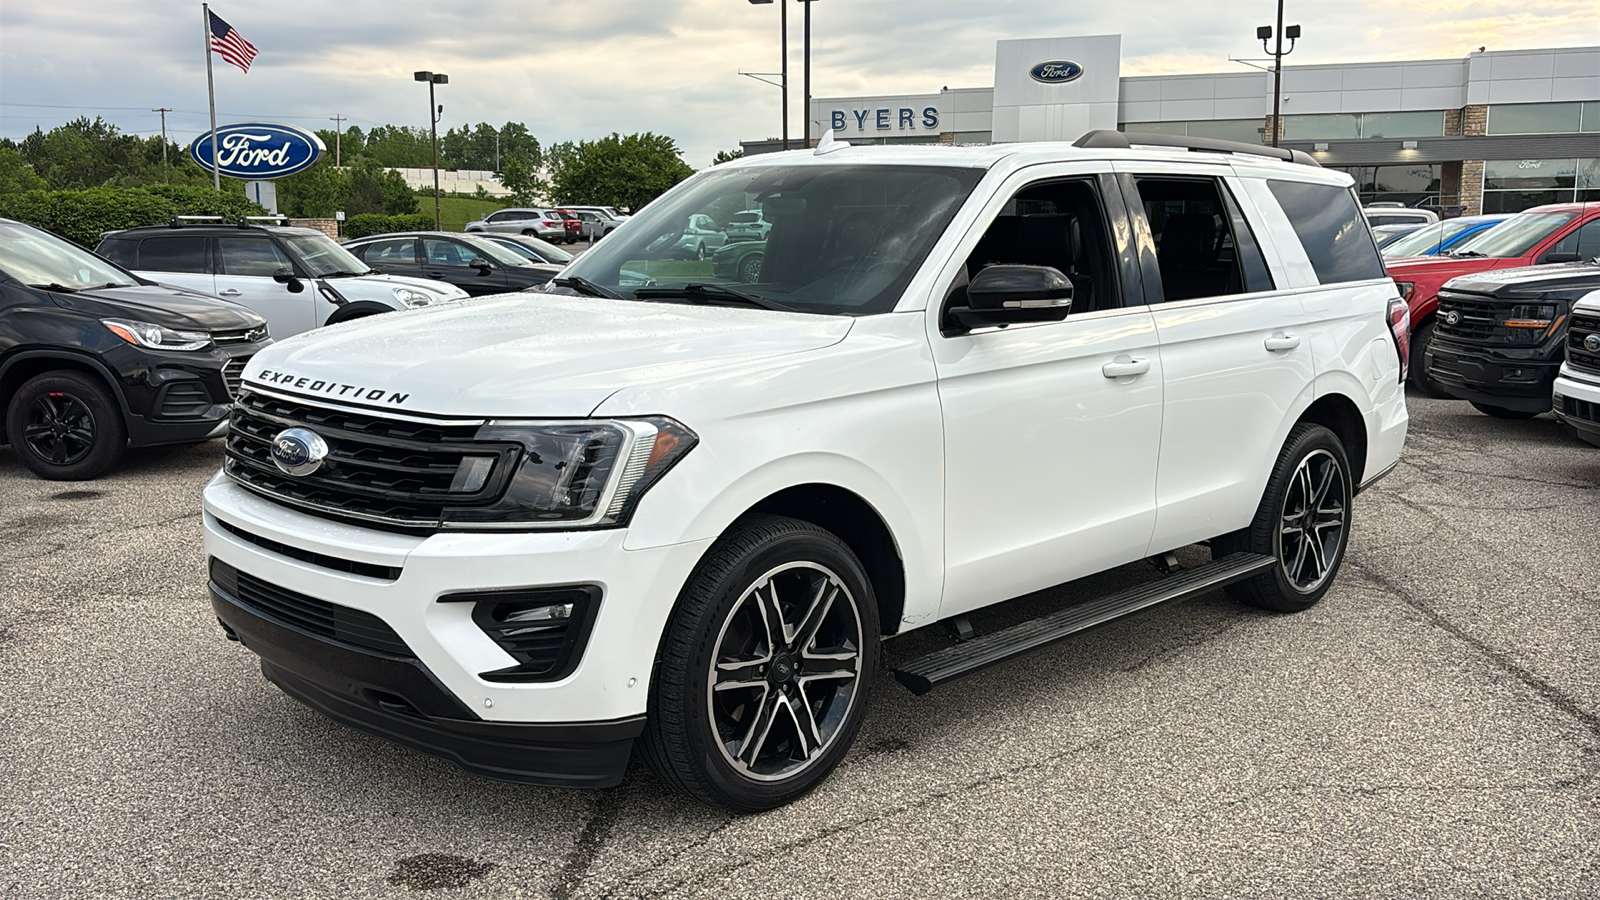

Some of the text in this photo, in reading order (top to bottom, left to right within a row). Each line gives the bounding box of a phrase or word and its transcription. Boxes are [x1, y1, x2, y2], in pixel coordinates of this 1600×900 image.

[1040, 64, 1071, 78] Ford
[831, 106, 940, 131] BYERS
[217, 133, 292, 167] Ford
[1518, 159, 1542, 169] Ford
[258, 369, 410, 404] EXPEDITION
[275, 439, 300, 461] Ford
